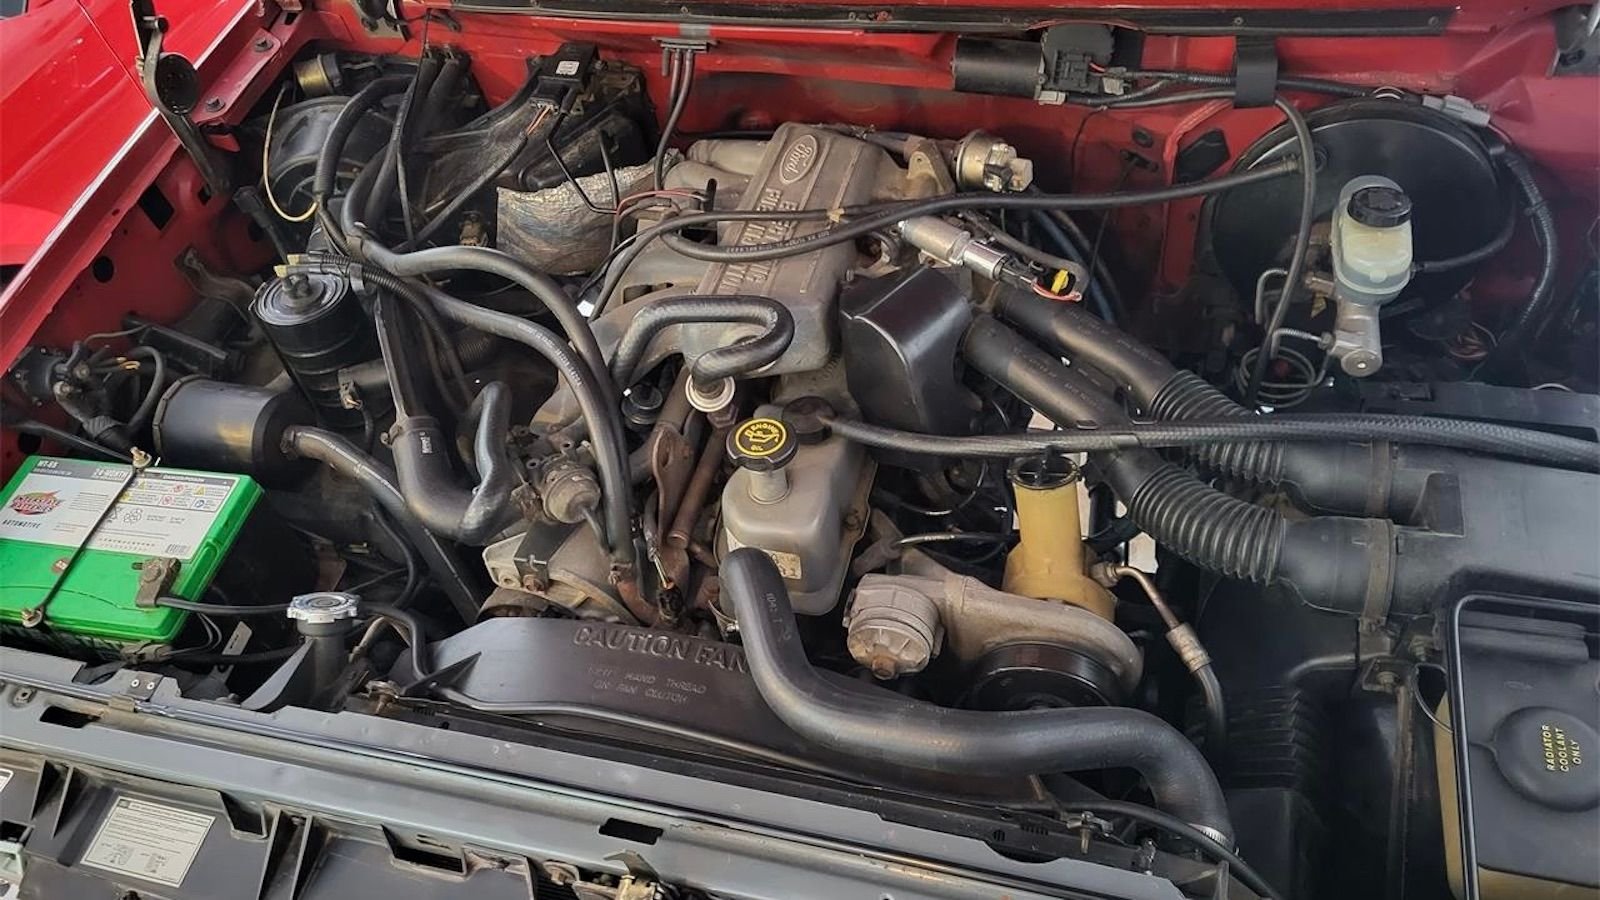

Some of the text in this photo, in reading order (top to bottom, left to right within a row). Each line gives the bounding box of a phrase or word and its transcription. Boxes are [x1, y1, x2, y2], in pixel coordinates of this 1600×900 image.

[784, 143, 813, 174] Ford
[750, 423, 780, 435] ENGINE
[2, 519, 42, 530] AUTOMOTIVE
[573, 626, 748, 674] CAUTION FAN
[645, 688, 688, 703] CLUTCH
[667, 678, 707, 694] THREAD
[1541, 724, 1556, 771] RADIATOR
[1555, 727, 1569, 772] COOLANT
[1569, 739, 1582, 765] ONLY
